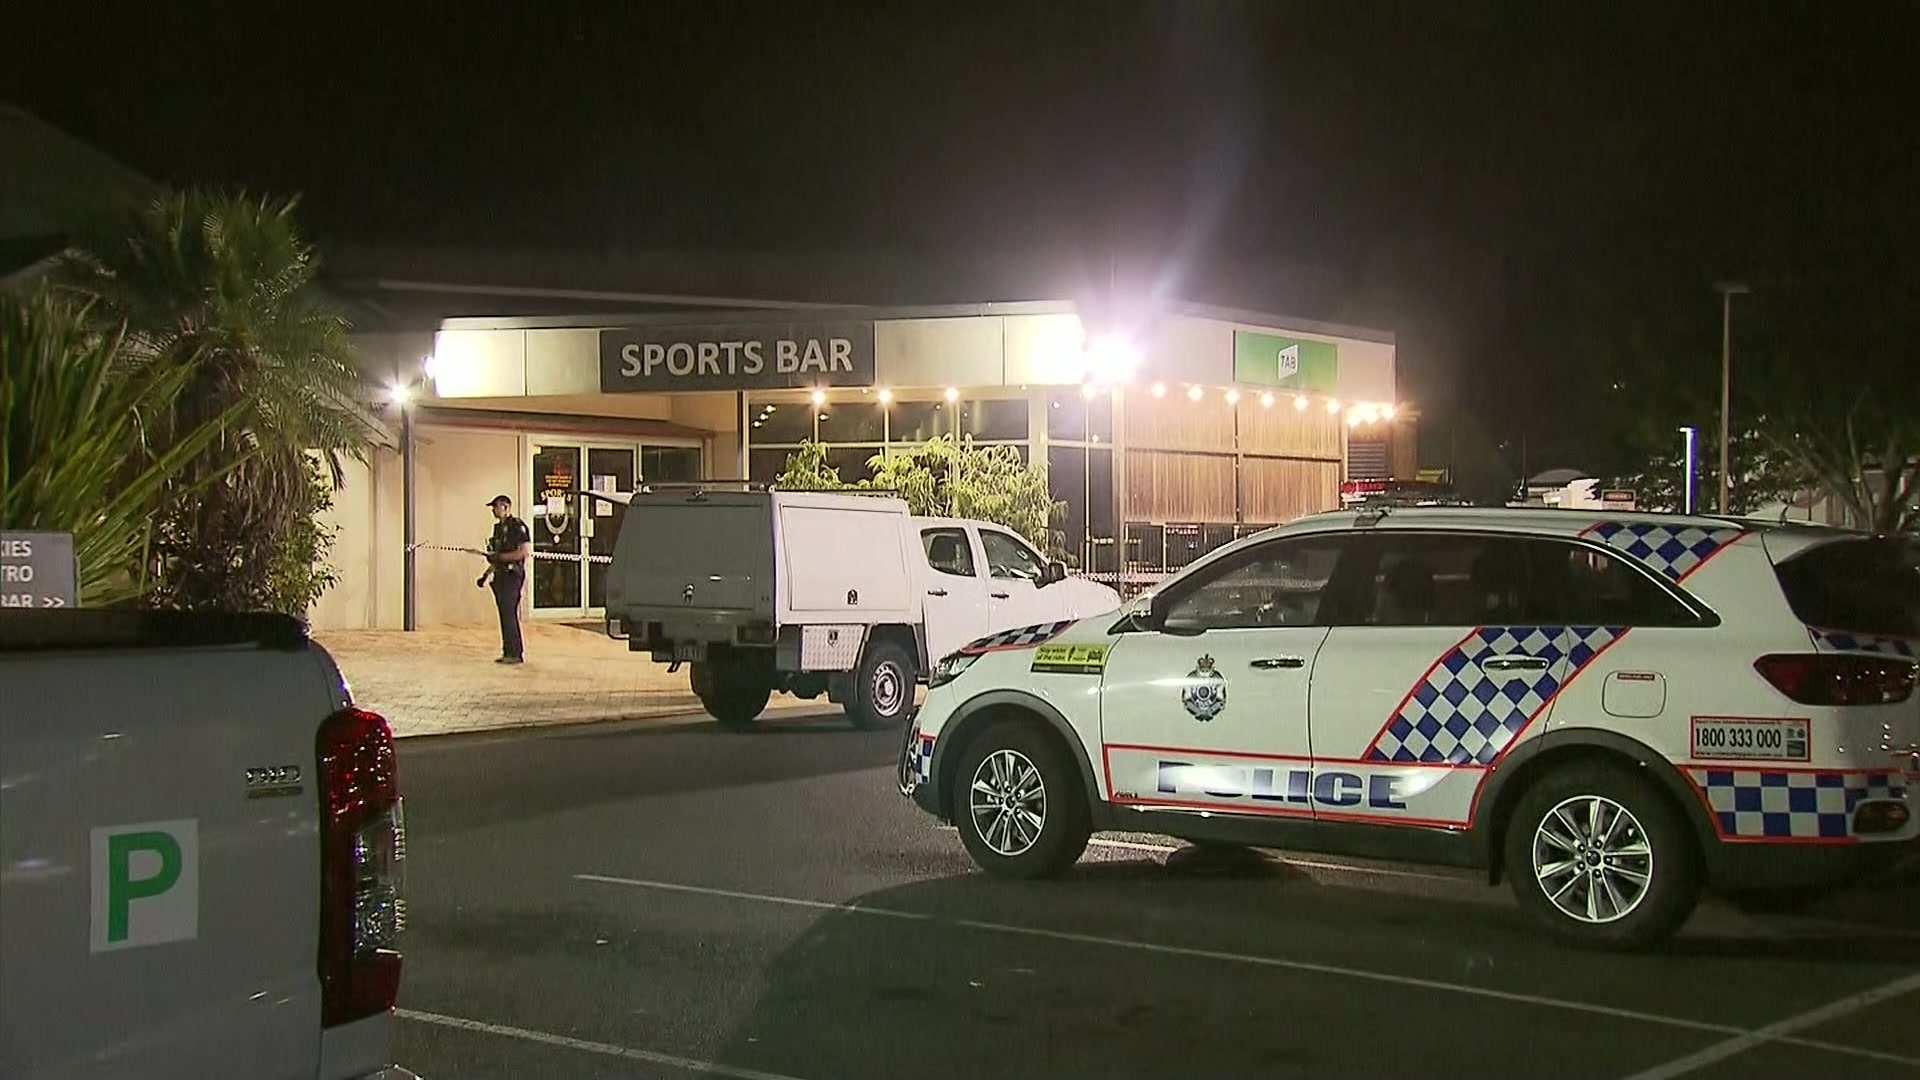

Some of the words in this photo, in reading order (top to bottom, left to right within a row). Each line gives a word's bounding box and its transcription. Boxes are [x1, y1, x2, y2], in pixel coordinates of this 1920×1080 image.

[621, 340, 764, 377] SPORTS
[776, 338, 853, 374] BAR
[1696, 727, 1725, 747] 1800
[1729, 728, 1753, 748] 333
[1756, 728, 1781, 749] 000
[1157, 760, 1408, 809] PLICE
[108, 831, 183, 944] P
